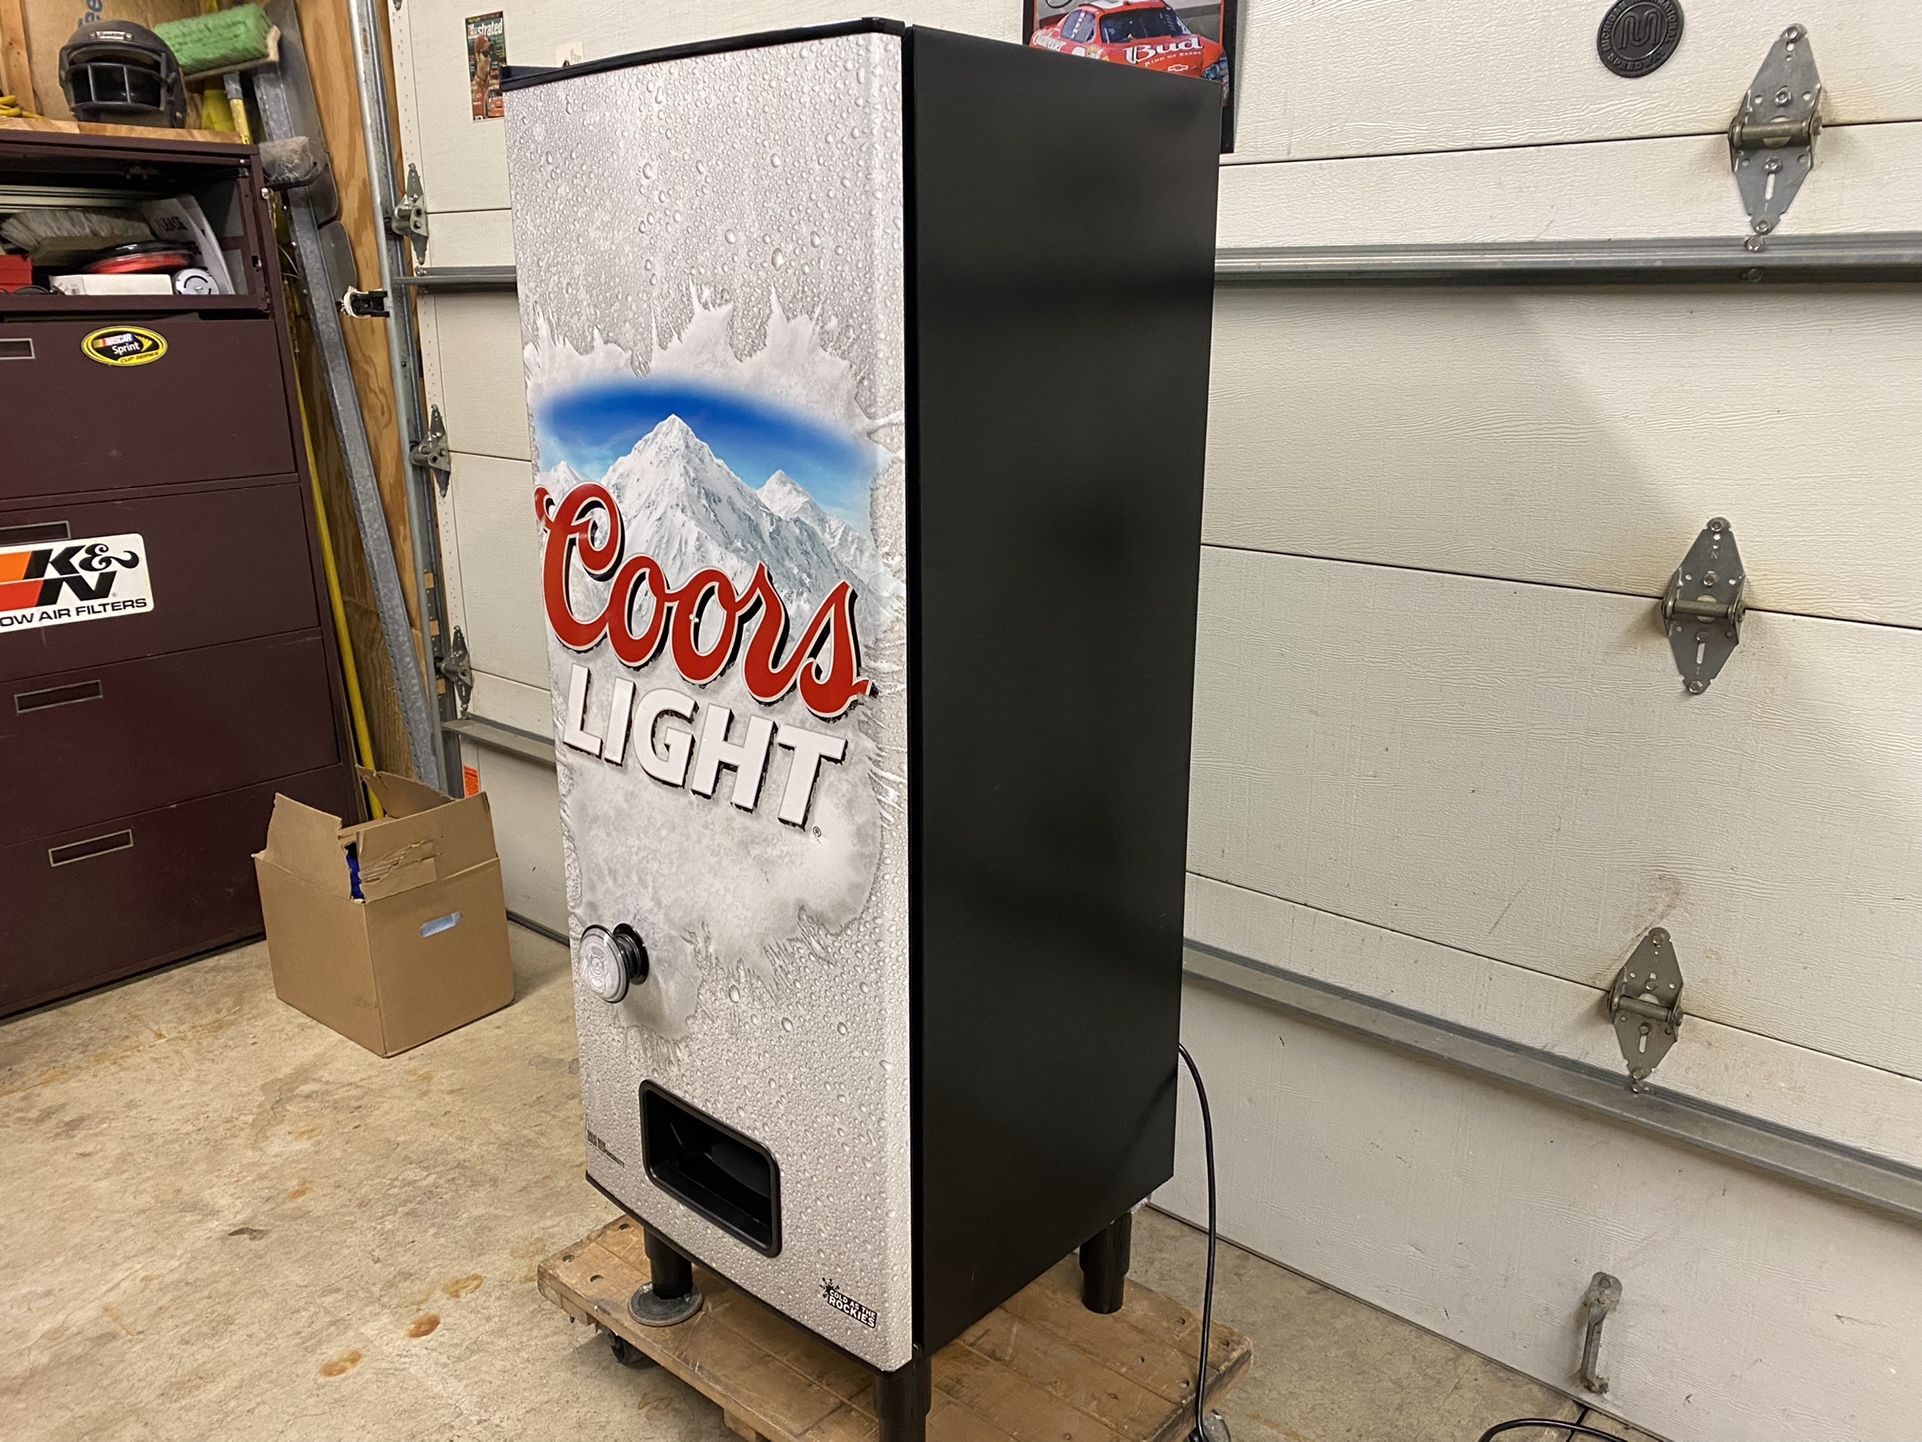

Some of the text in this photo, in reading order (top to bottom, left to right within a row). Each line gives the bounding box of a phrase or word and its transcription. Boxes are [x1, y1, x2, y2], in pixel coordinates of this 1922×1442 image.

[1123, 37, 1204, 64] Bud
[112, 341, 141, 355] Sprint
[40, 608, 71, 621] AIR
[75, 598, 147, 616] FILTERS
[534, 482, 876, 721] Coors
[563, 663, 848, 831] LIGHT
[829, 1289, 876, 1319] COLD AS THE
[829, 1295, 875, 1328] ROCKIES
